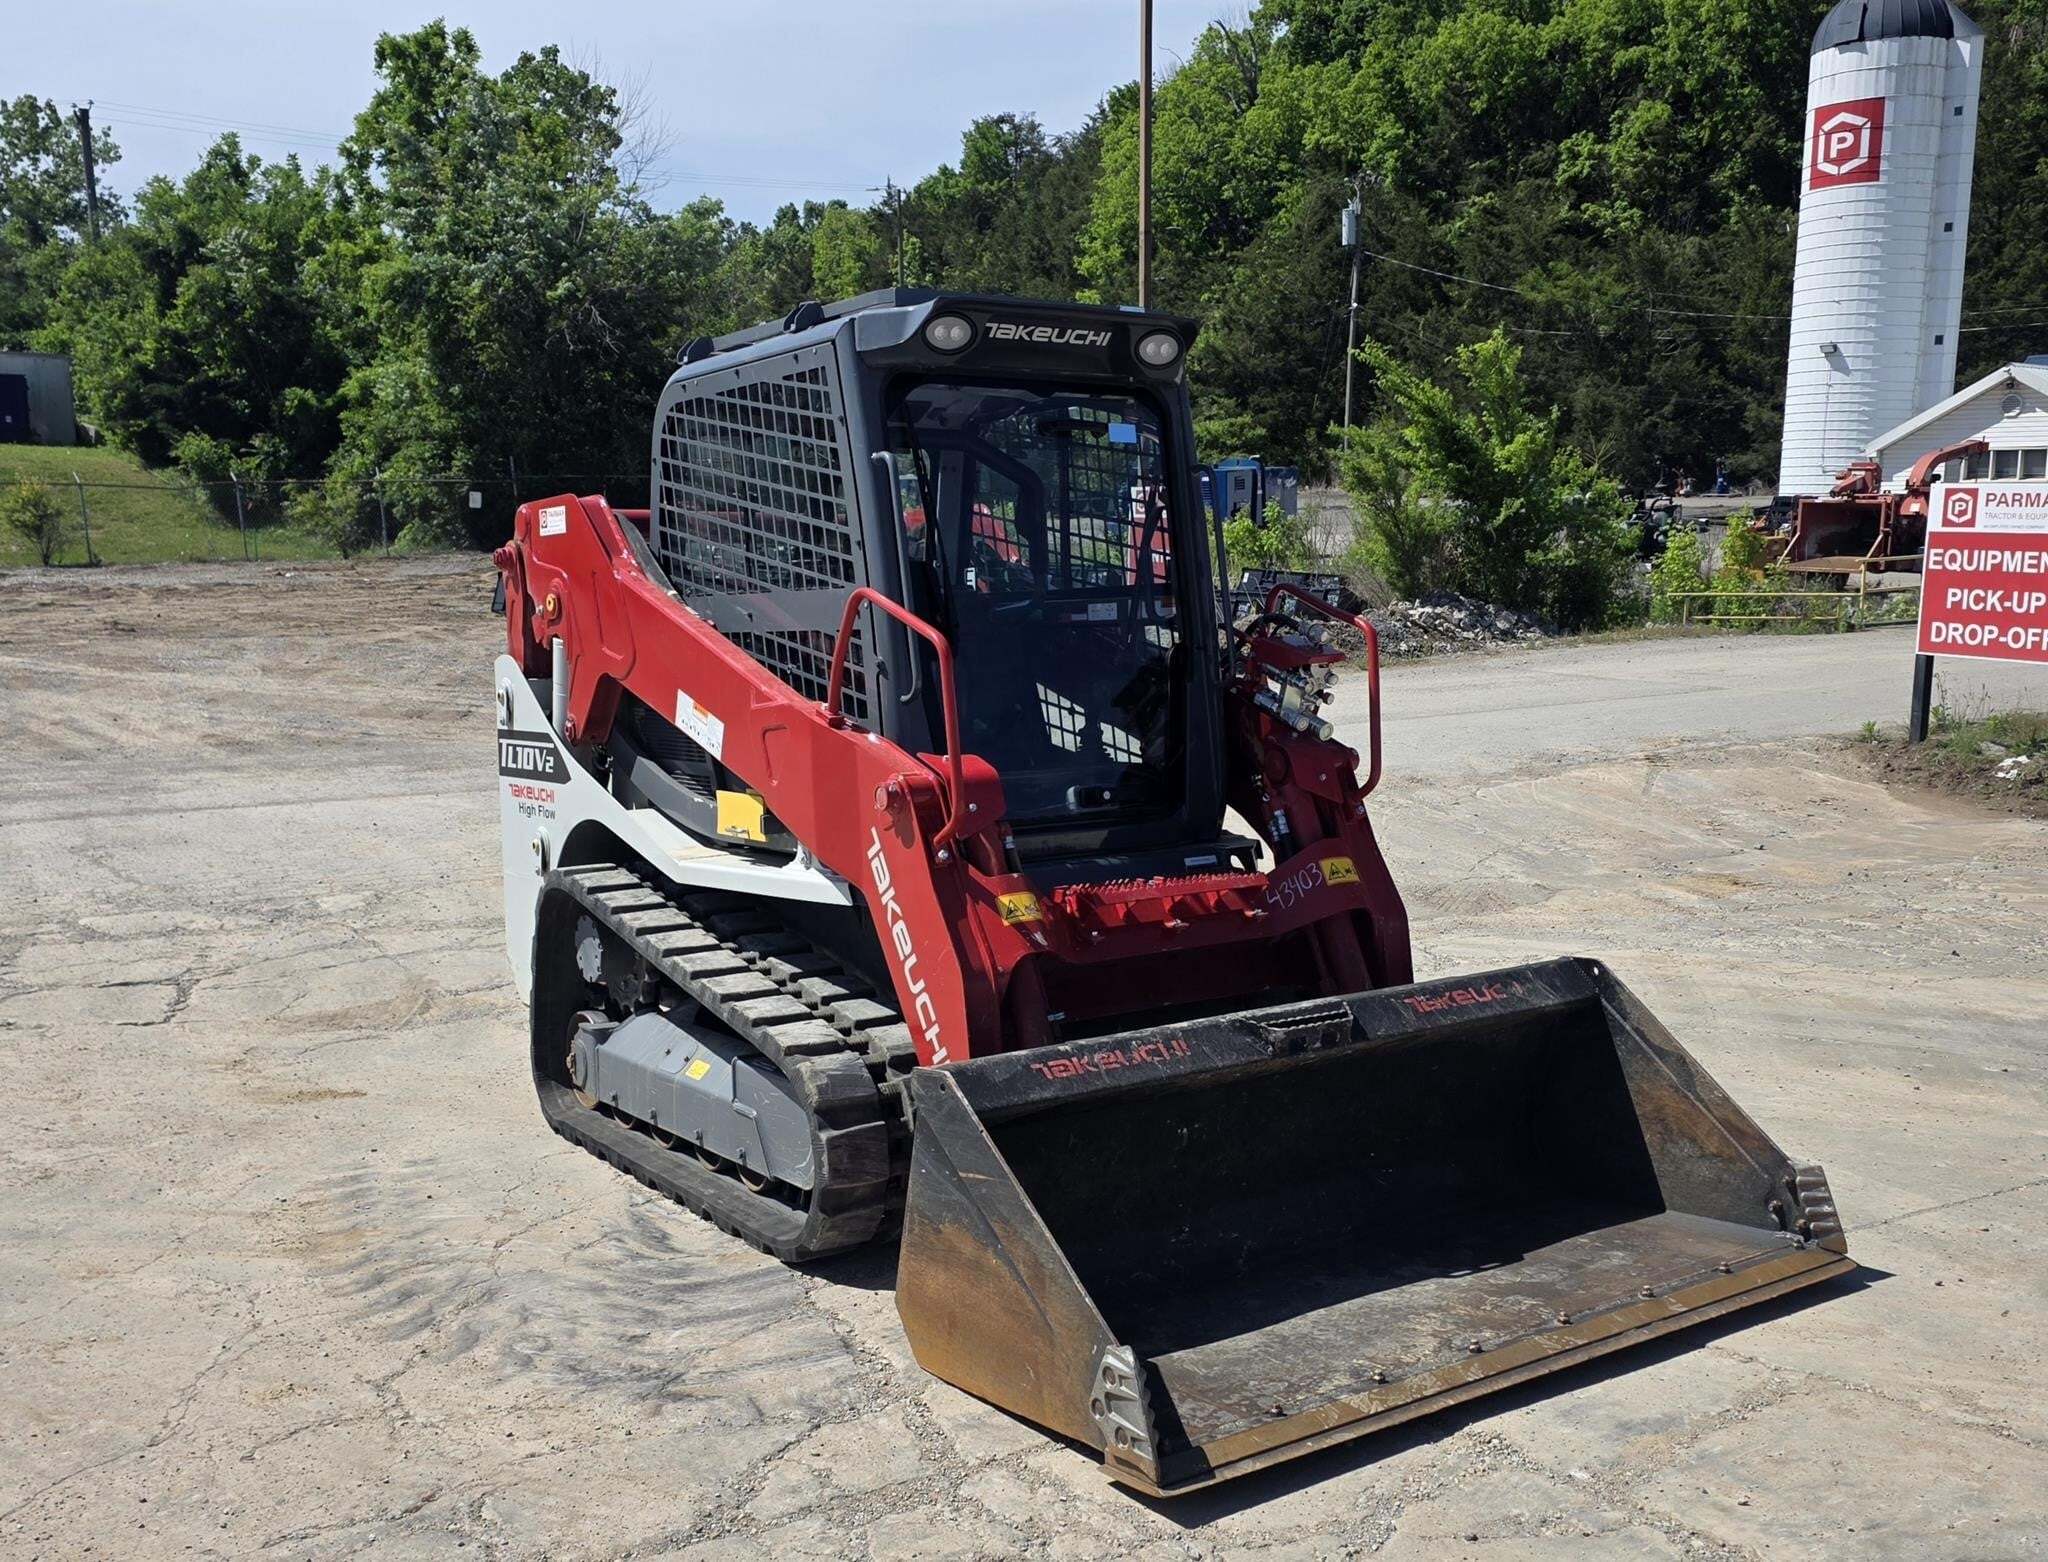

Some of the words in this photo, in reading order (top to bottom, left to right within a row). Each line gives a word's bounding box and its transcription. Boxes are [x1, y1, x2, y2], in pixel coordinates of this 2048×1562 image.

[1830, 131, 1855, 159] P
[985, 322, 1112, 346] TAKEUCHI
[1953, 501, 1967, 515] P
[1985, 512, 2016, 520] TRACTOR
[1946, 587, 2047, 614] PICK-UP
[499, 738, 555, 773] TL10V2
[509, 783, 555, 803] TAKEUCHI
[519, 802, 537, 819] High
[538, 804, 556, 820] Flow
[1266, 862, 1323, 910] 43403
[867, 825, 951, 1066] TAKEUCH
